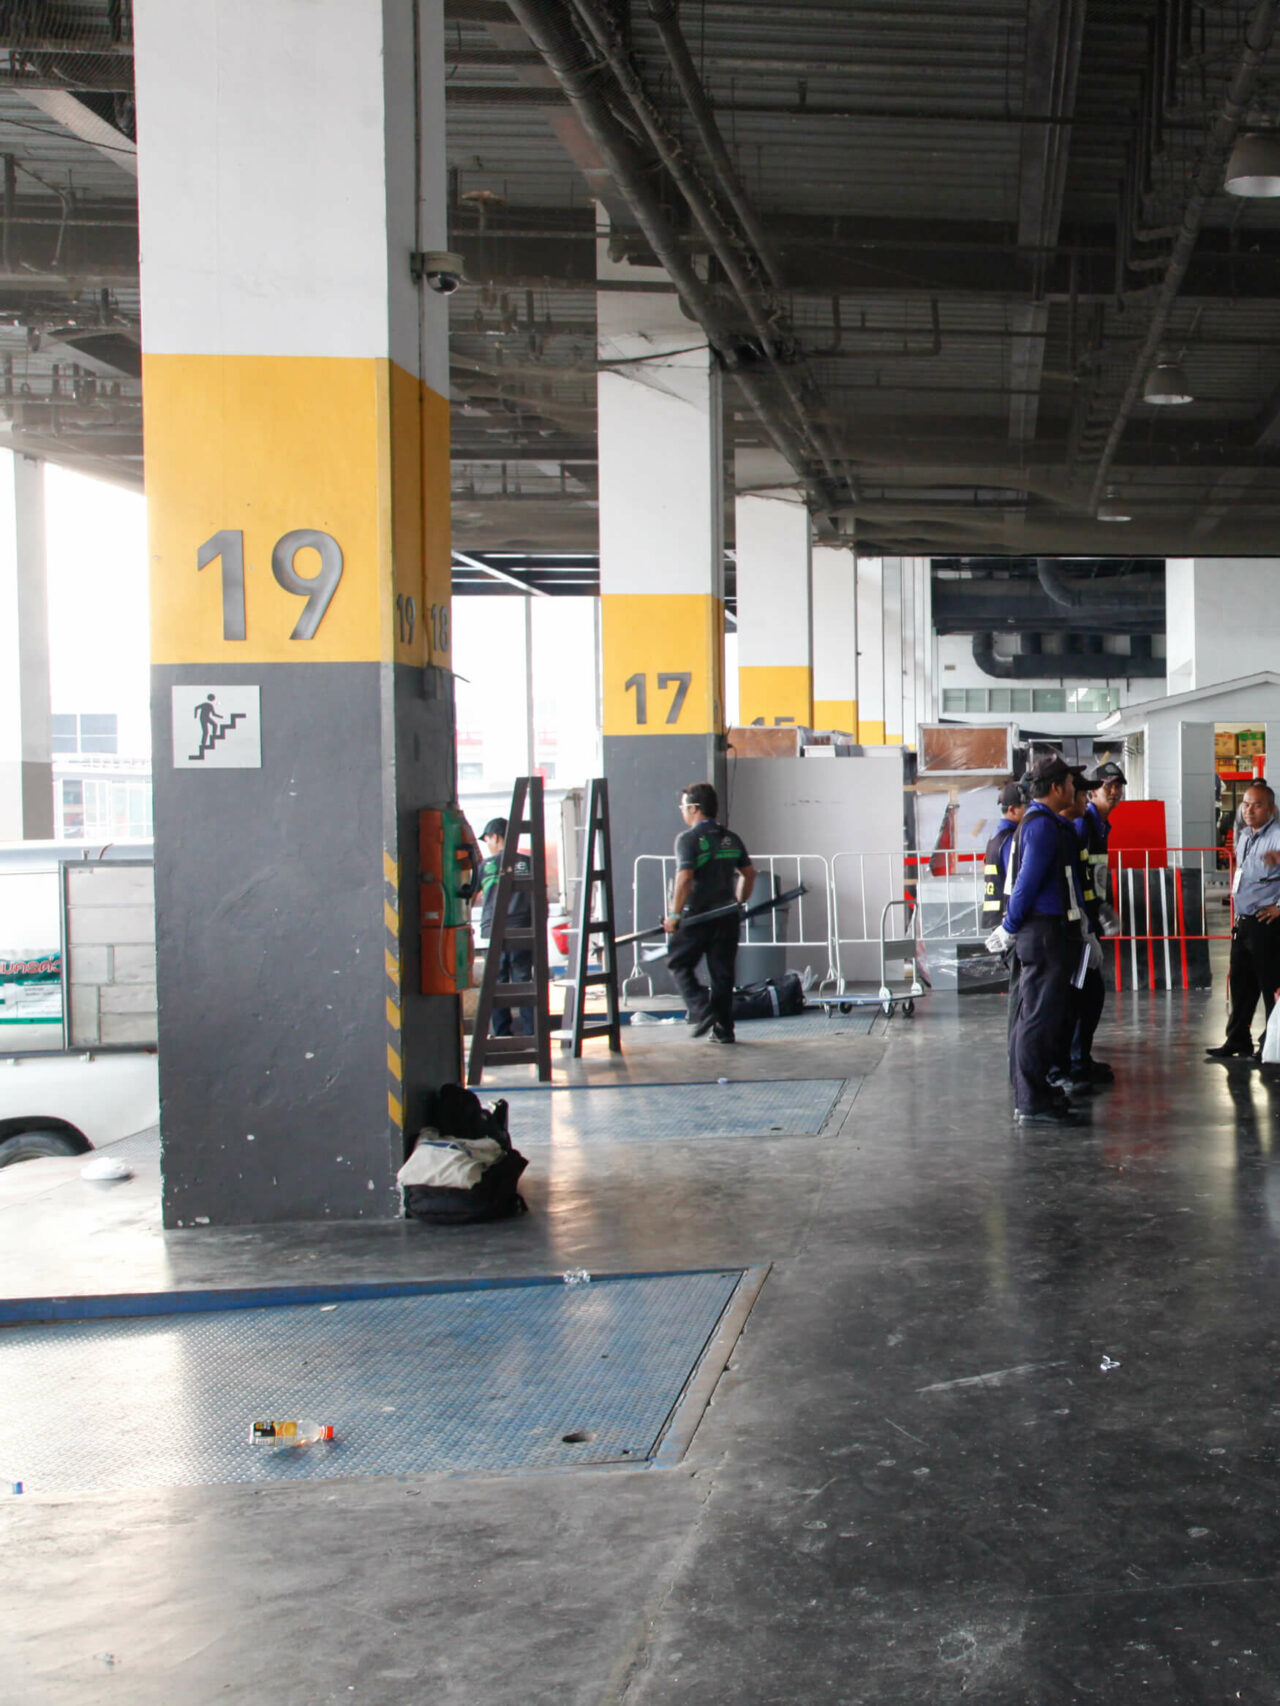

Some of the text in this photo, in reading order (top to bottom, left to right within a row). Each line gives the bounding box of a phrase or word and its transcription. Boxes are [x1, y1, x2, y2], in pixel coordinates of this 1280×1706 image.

[197, 528, 343, 640] 19
[397, 593, 416, 645] 19
[431, 604, 449, 653] 18
[625, 672, 691, 724] 17
